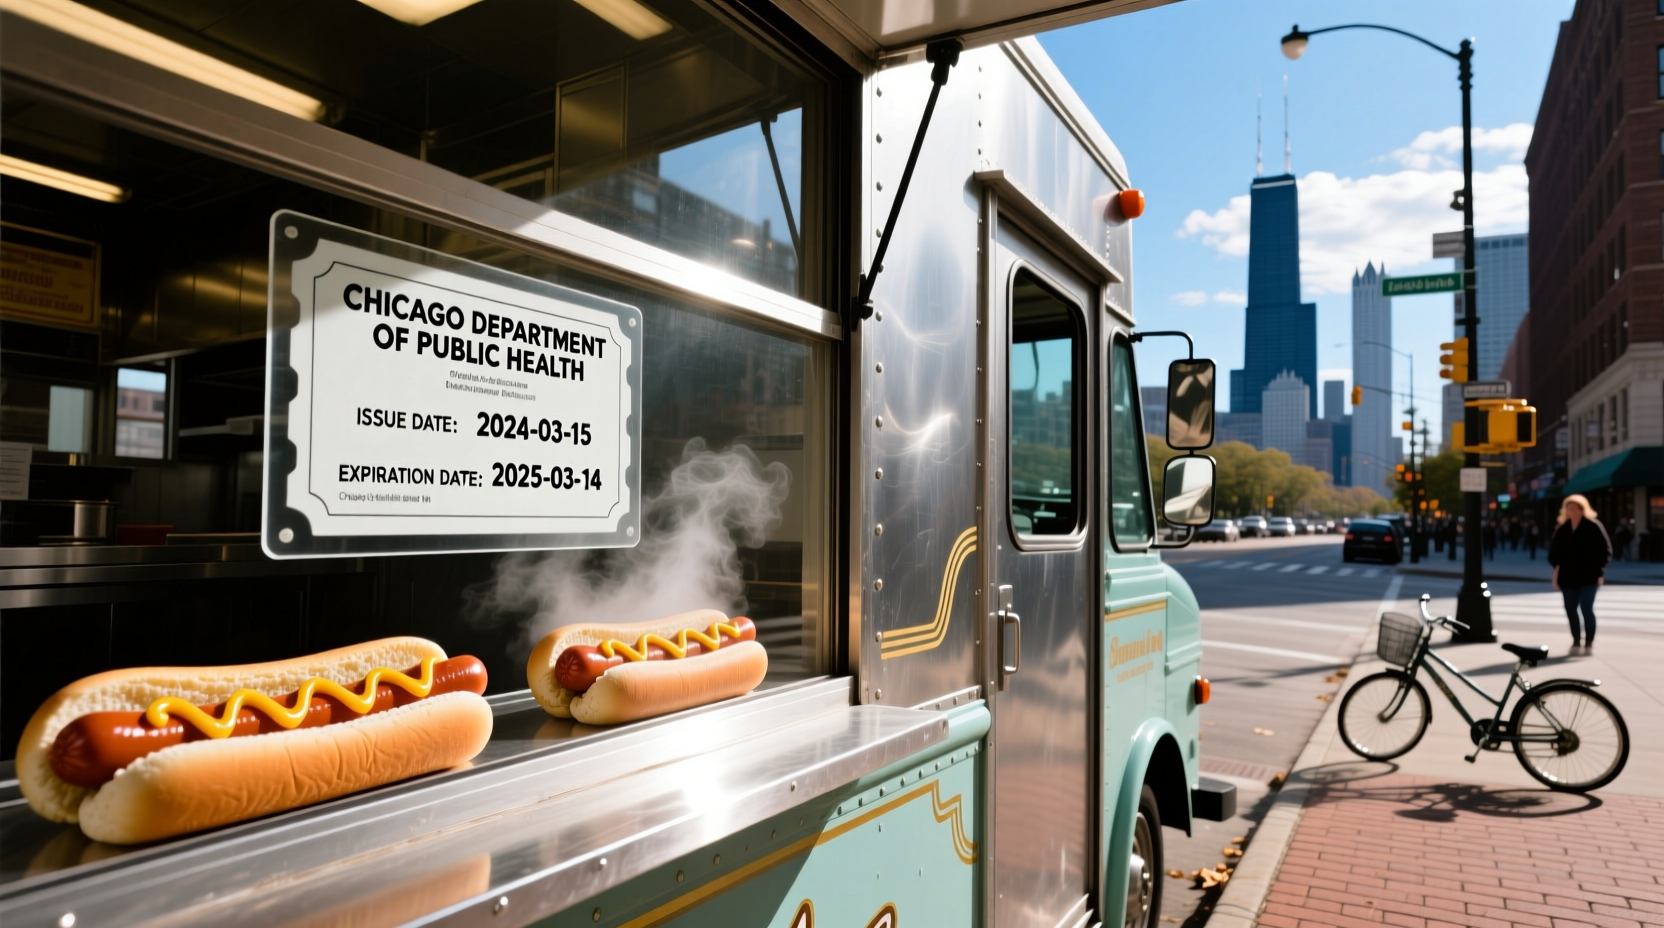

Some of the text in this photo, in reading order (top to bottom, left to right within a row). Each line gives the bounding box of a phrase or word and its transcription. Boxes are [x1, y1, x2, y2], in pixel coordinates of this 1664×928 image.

[343, 283, 607, 358] CHICAGO DEPARTMENT
[372, 323, 410, 352] OF
[417, 330, 500, 367] PUBLIC
[506, 346, 584, 382] HEALTH
[356, 407, 592, 446] ISSUE DATE: 2024-03-15
[338, 461, 602, 491] EXPIRATION DATE: 2025-03-14
